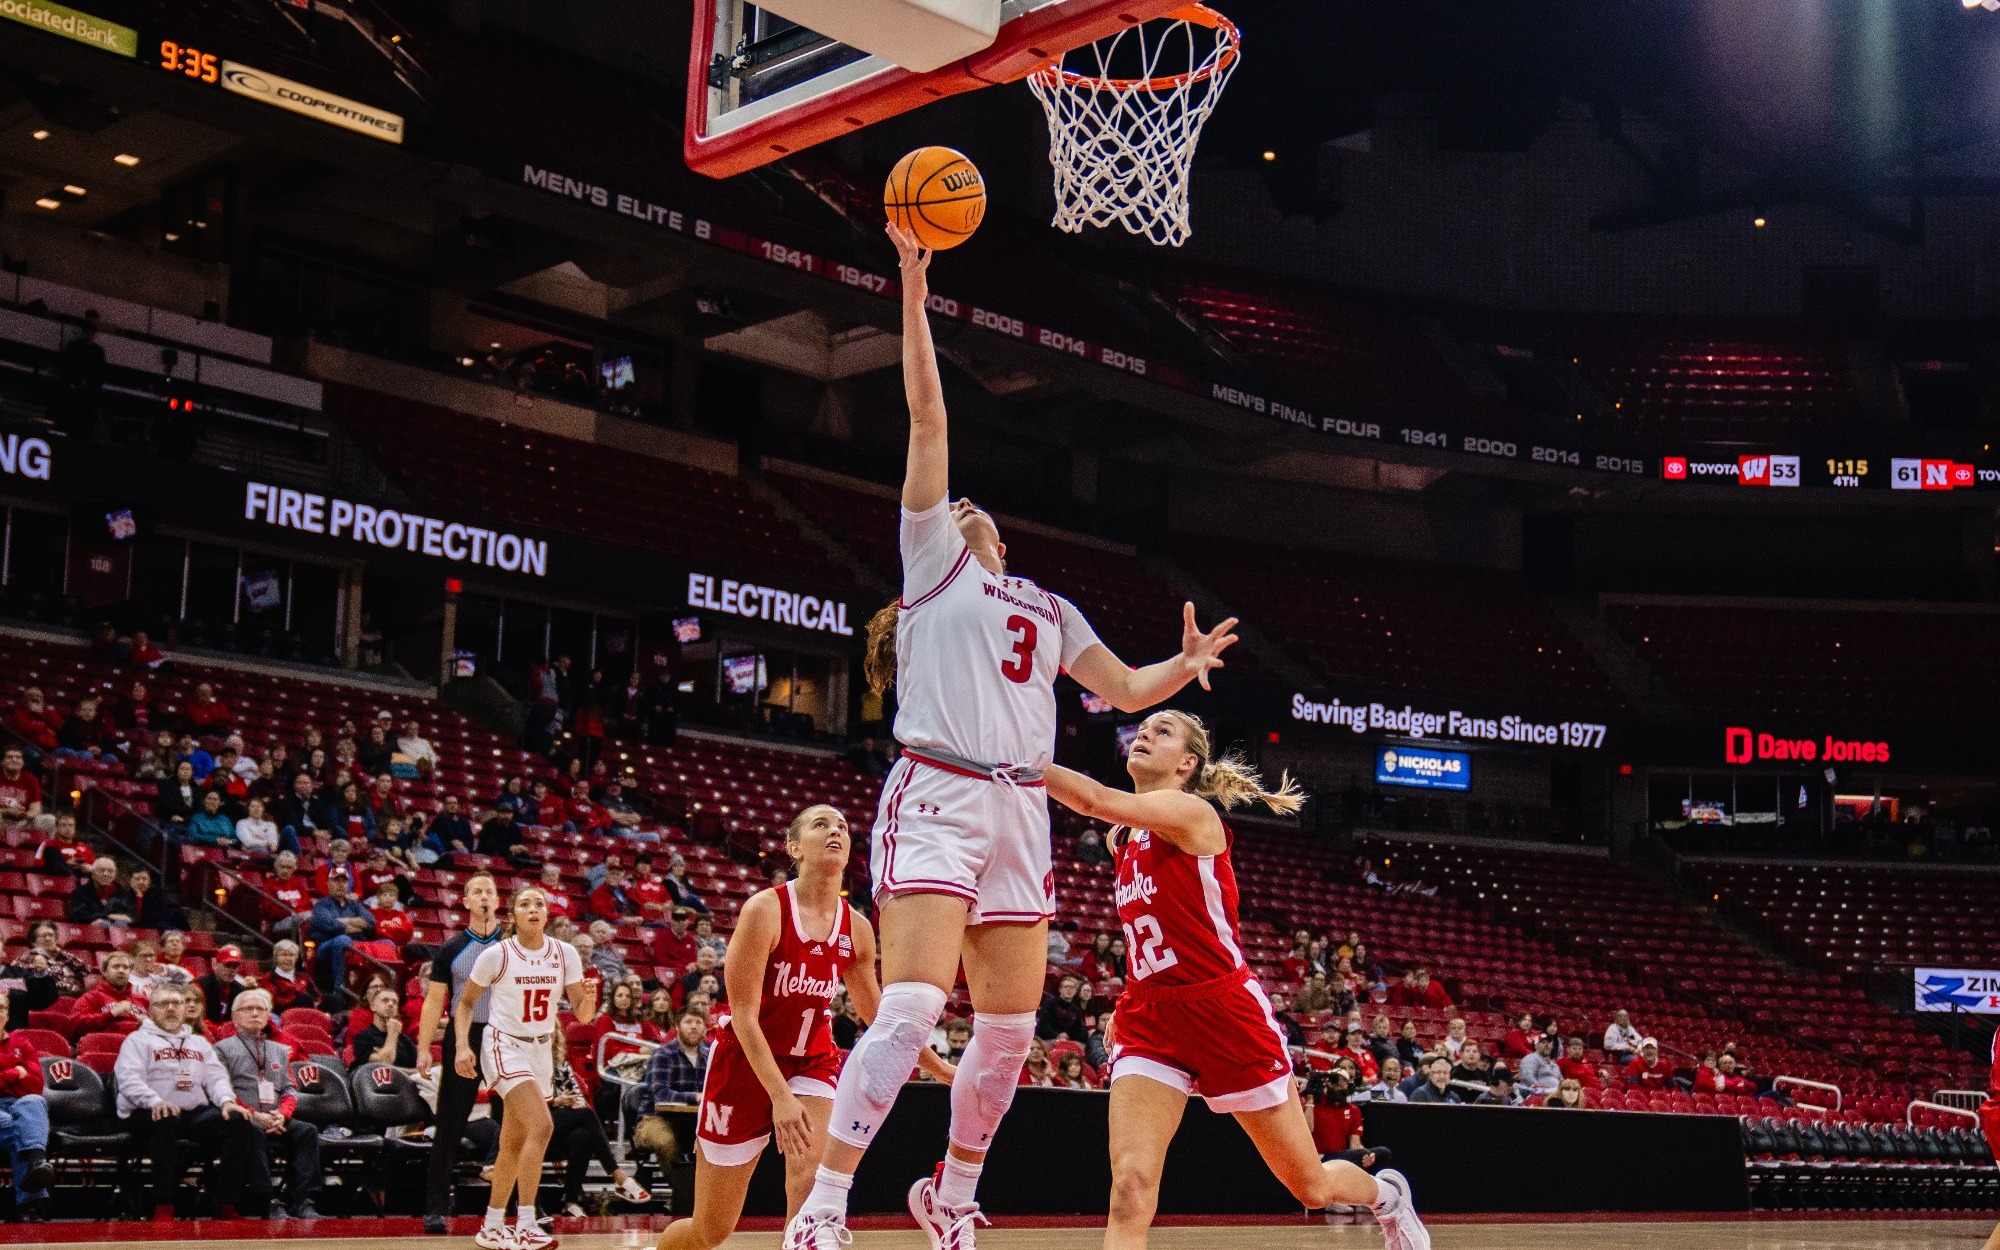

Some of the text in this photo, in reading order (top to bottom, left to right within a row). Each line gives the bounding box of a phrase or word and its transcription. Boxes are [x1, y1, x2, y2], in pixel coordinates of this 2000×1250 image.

[0, 0, 119, 49] ociatedBank
[160, 40, 219, 84] 9:35
[523, 164, 712, 240] MEN'S ELITE 8
[760, 241, 813, 272] 1941
[836, 264, 886, 293] 1947
[971, 308, 1024, 338] 2005
[1039, 328, 1085, 356] 2014
[1102, 348, 1147, 375] 2015
[1212, 383, 1644, 475] MEN'S FINAL FOUR 1941 2000 2014 2015
[1690, 463, 1739, 476] TOYOTA
[1773, 463, 1797, 478] 53
[1826, 459, 1868, 476] 1:15
[1833, 476, 1859, 487] 4TH
[1898, 466, 1918, 481] 61
[1926, 464, 1948, 486] N
[245, 482, 548, 576] FIRE PROTECTION
[687, 573, 853, 635] ELECTRICAL
[982, 582, 1055, 627] WISCONSIN
[1001, 614, 1037, 683] 3
[1291, 693, 1607, 748] Serving Badger Fans Since 1977
[1398, 756, 1461, 773] NICHOLAS
[1758, 733, 1816, 760] Dave
[1822, 735, 1890, 762] Jones
[514, 976, 557, 985] WISCONSIN
[773, 961, 839, 1004] Nebrask
[522, 989, 552, 1023] 15
[790, 1008, 816, 1057] 1
[705, 1101, 734, 1136] N
